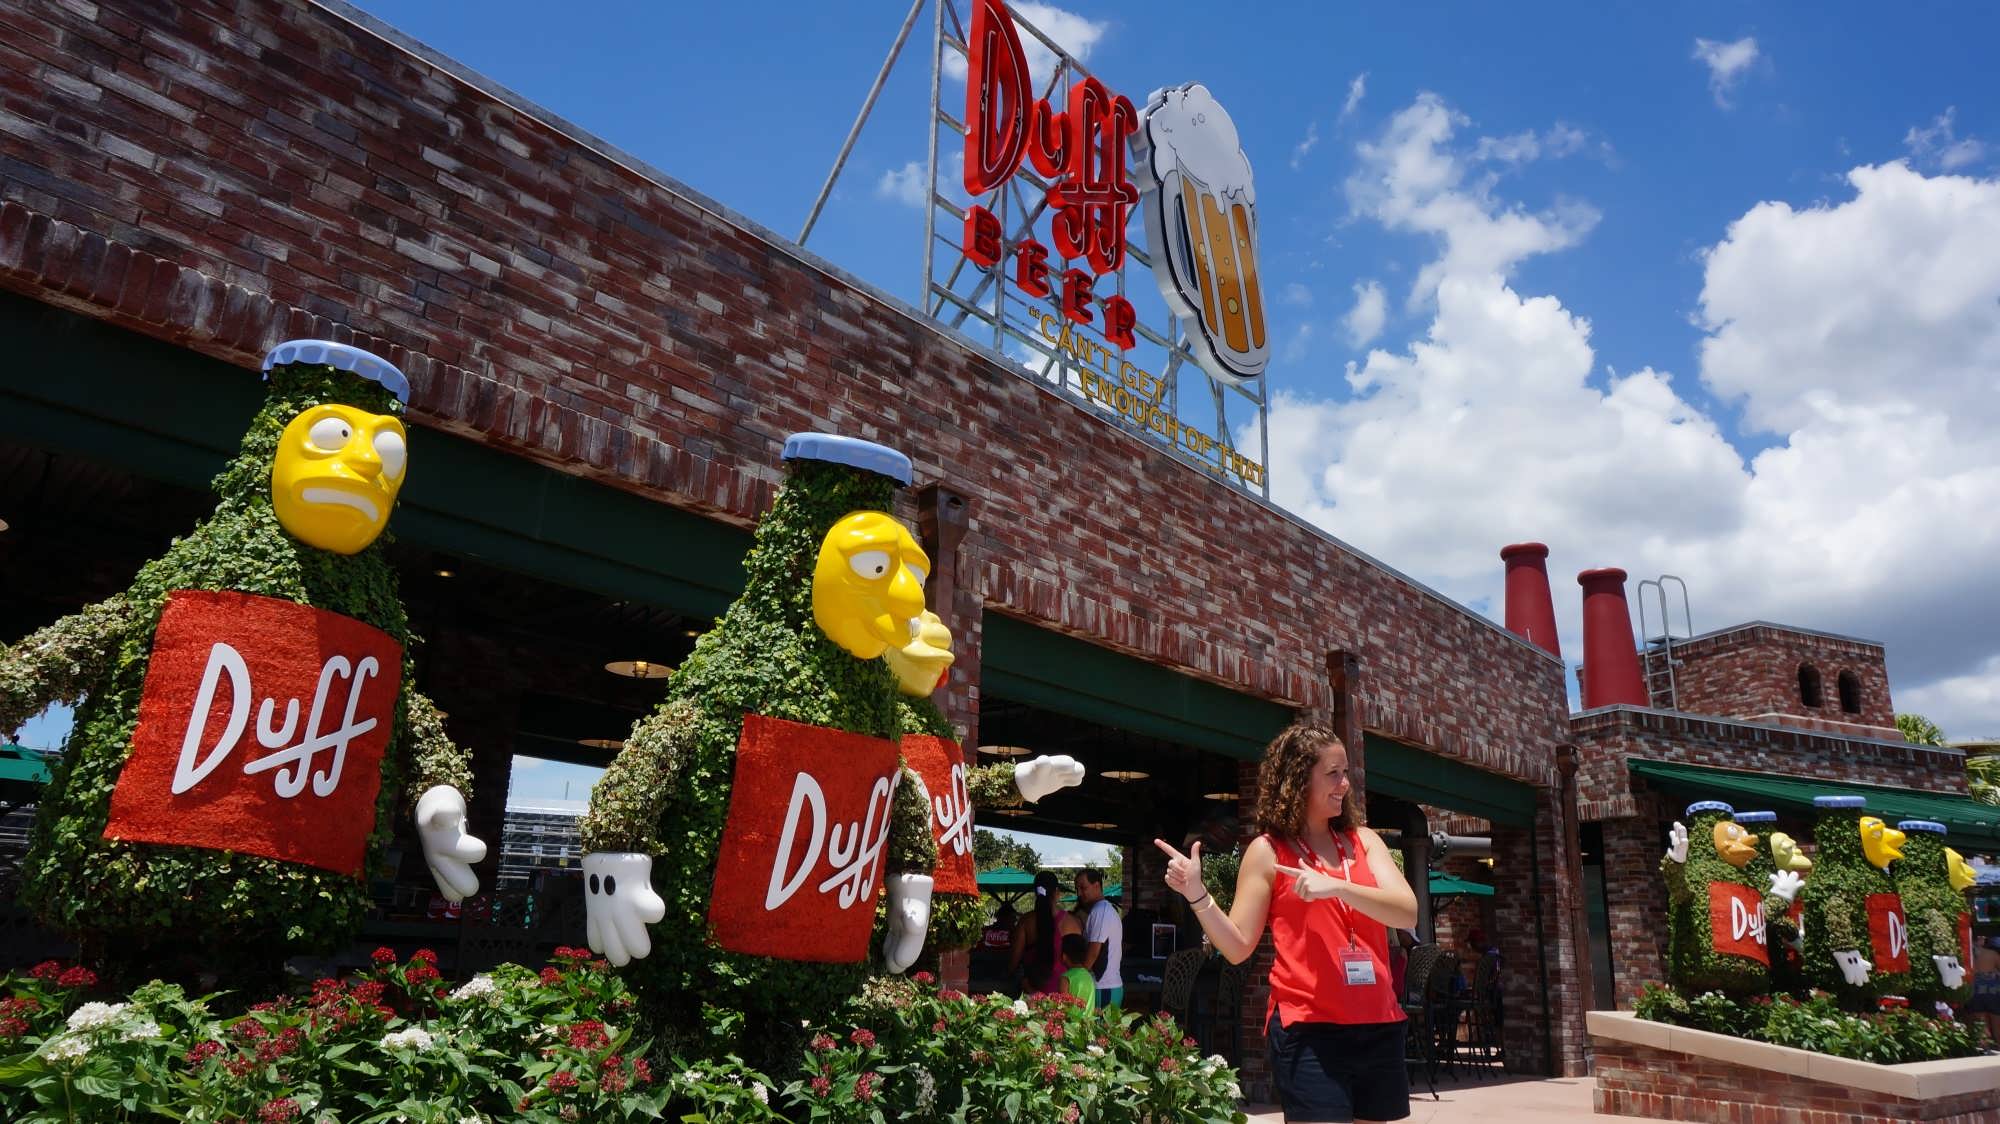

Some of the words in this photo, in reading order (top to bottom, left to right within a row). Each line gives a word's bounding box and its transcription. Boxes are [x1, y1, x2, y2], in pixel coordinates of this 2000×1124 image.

[964, 0, 1139, 274] Duff
[963, 205, 1136, 351] BEER
[1081, 367, 1180, 441] ENOUGH
[1186, 426, 1213, 456] OF
[1219, 443, 1264, 487] THAT
[1121, 360, 1165, 403] GET
[171, 642, 379, 799] Duff
[765, 768, 901, 910] Duff
